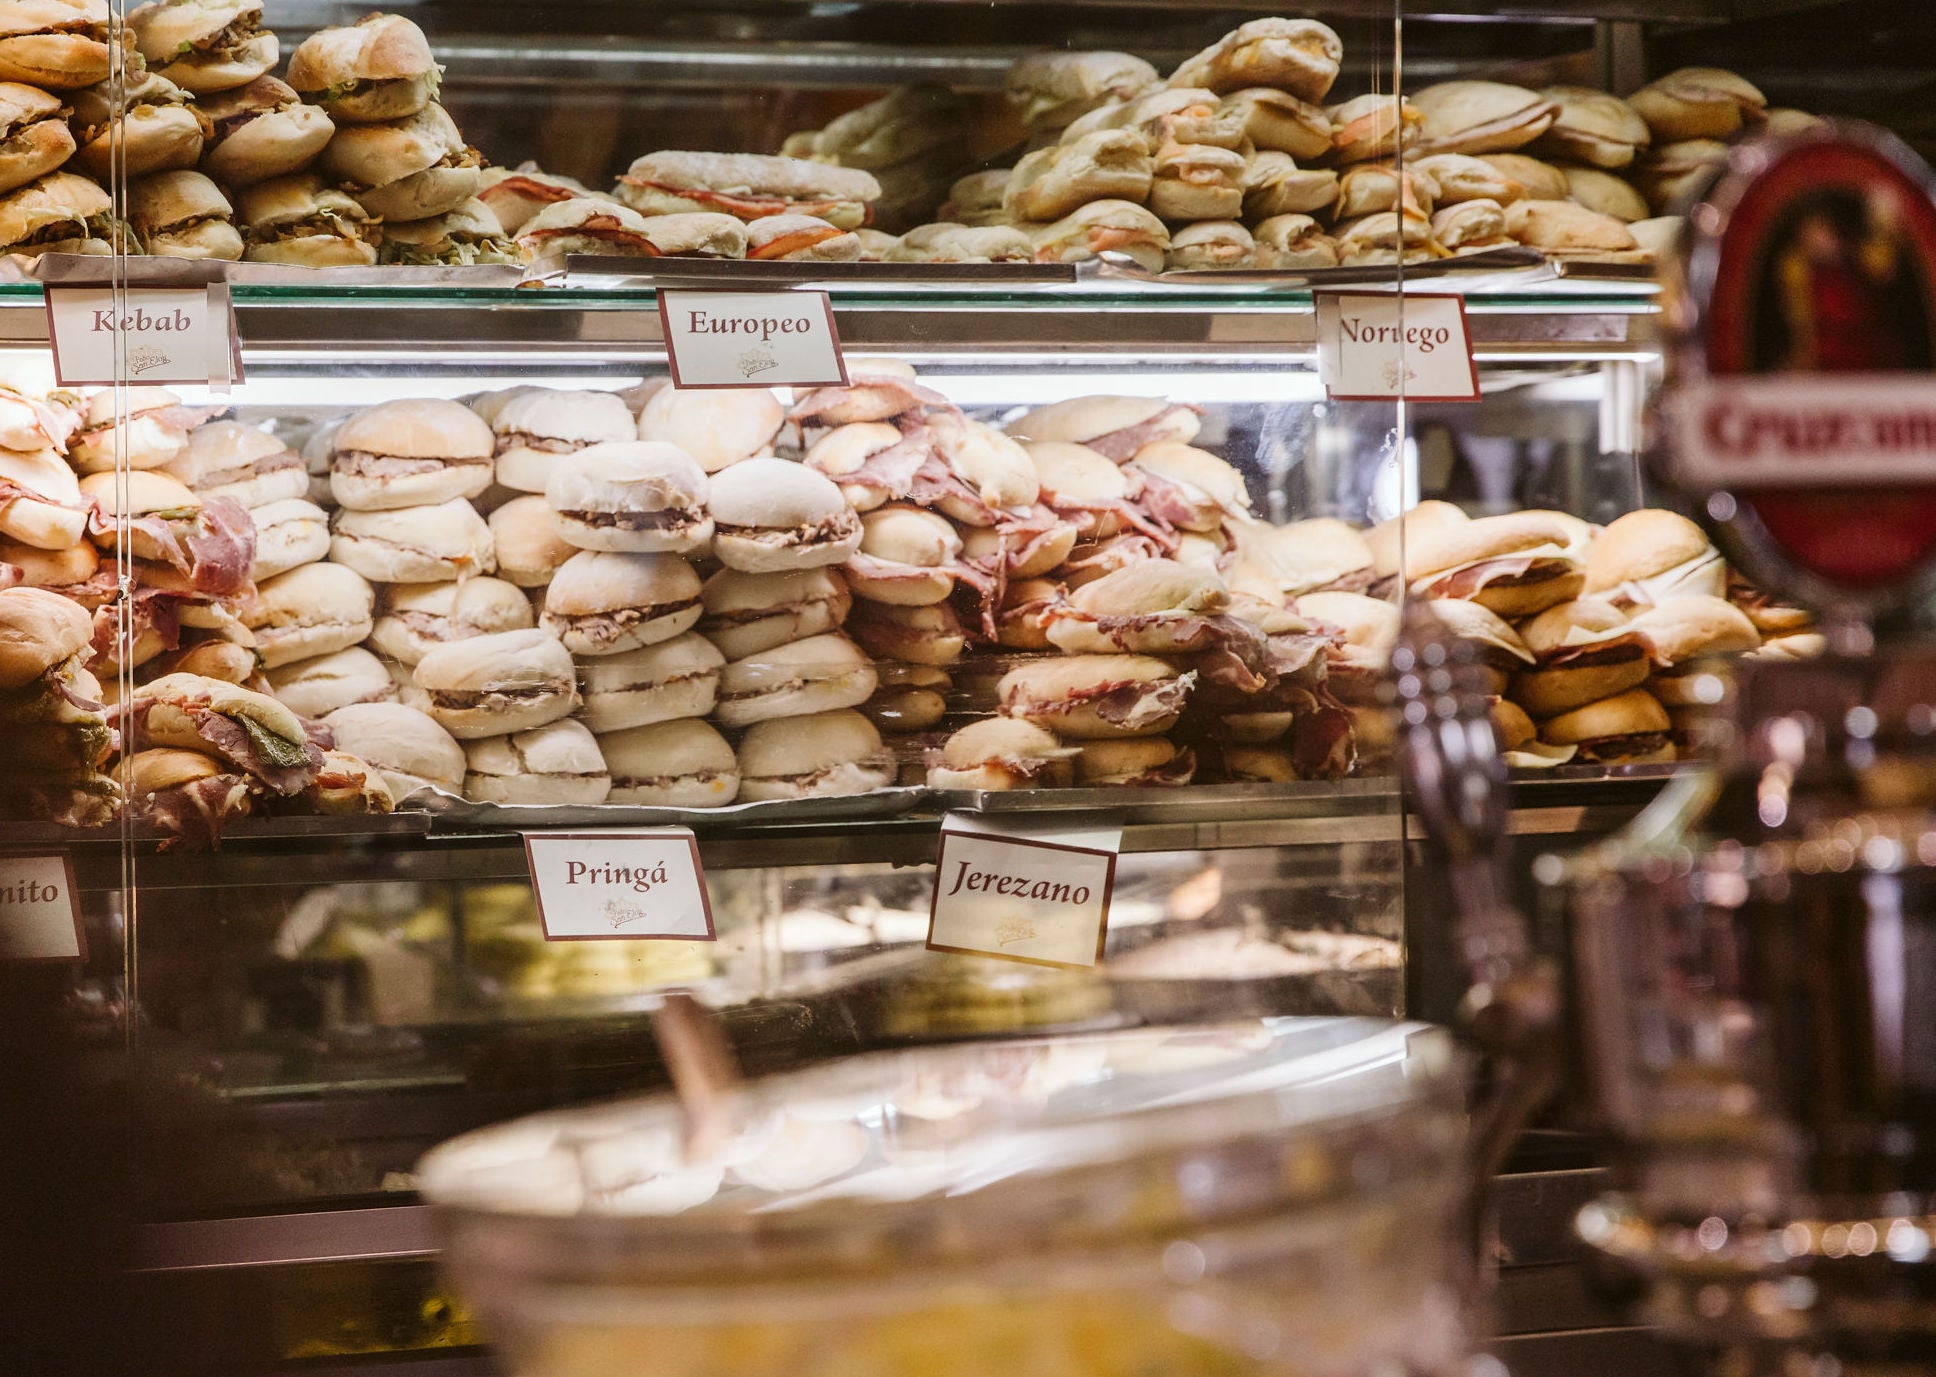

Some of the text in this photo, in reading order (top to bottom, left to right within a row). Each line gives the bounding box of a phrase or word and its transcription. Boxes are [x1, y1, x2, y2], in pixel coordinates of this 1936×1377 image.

[91, 308, 192, 332] Kebab
[687, 310, 811, 342] Europeo
[565, 860, 669, 893] Pringá
[948, 861, 1090, 906] Jerezano
